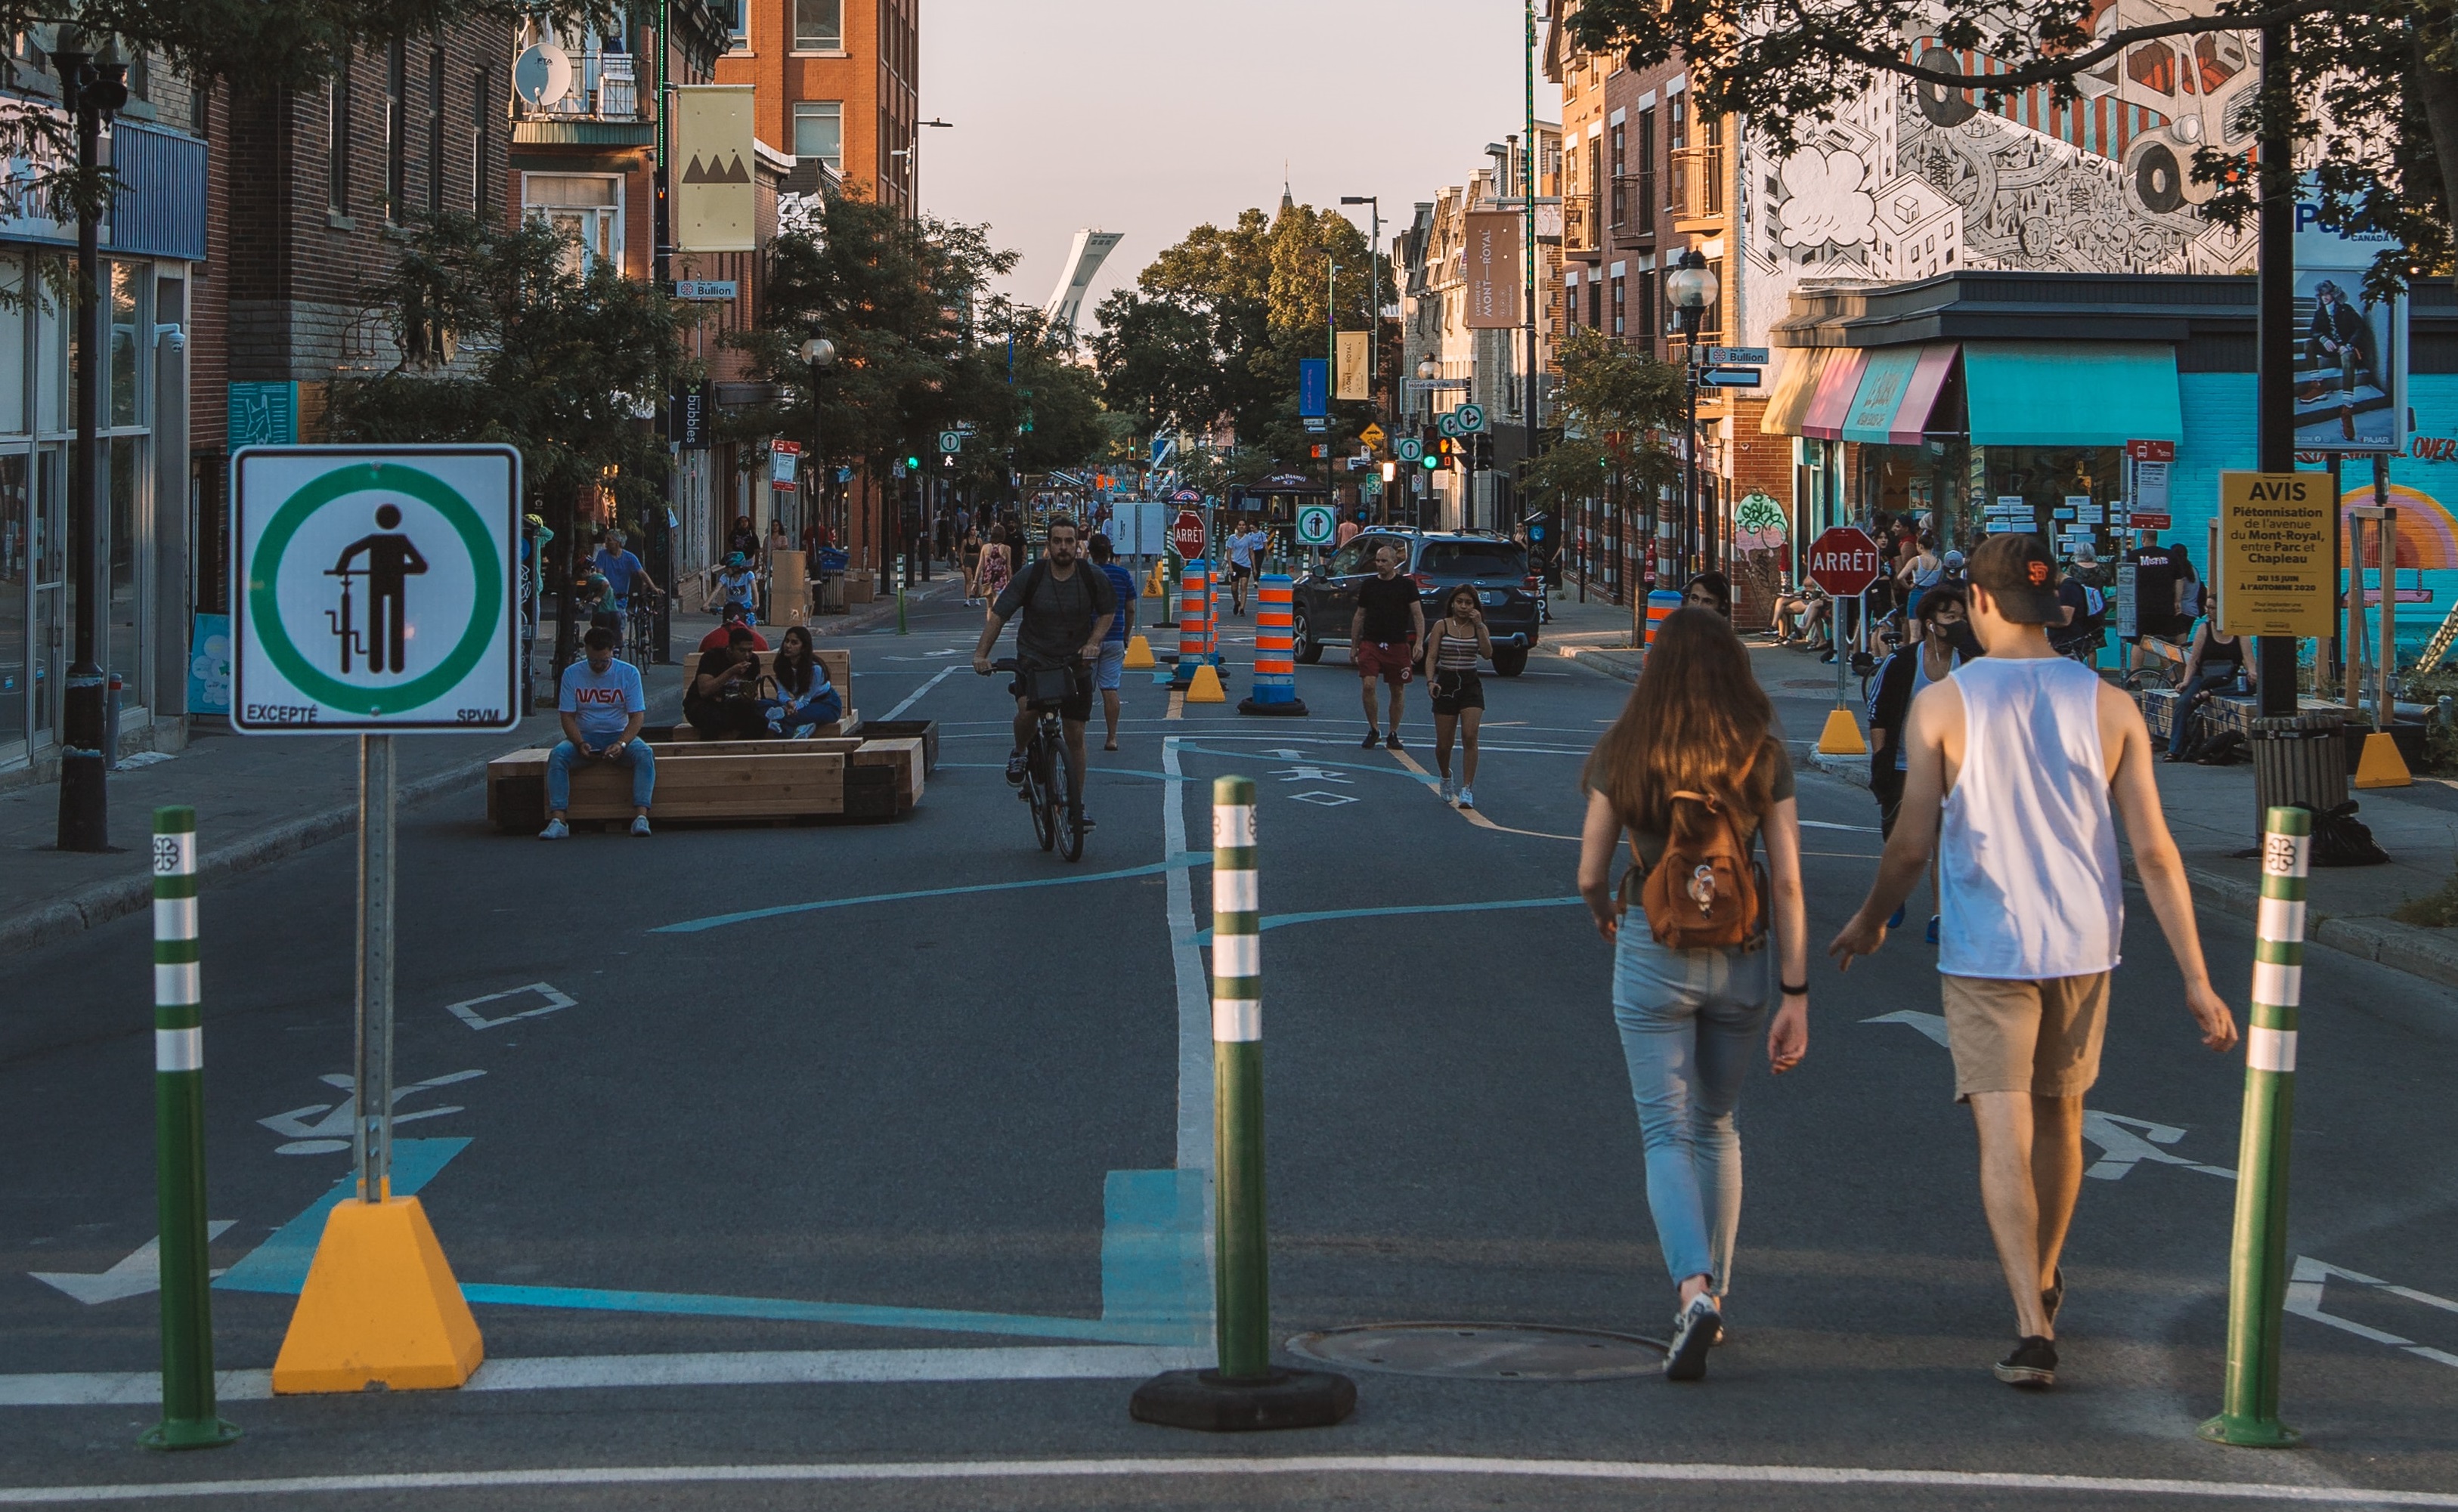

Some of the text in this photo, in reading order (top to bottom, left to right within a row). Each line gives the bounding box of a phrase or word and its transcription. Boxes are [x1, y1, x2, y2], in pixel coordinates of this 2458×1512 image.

[698, 286, 731, 295] Bullion
[1730, 352, 1764, 362] Bullion
[686, 395, 701, 444] bubbles
[2249, 481, 2307, 501] AVIS
[2233, 506, 2323, 518] Piétonnisation
[2244, 518, 2311, 529] de l'avenue
[1175, 527, 1203, 543] ARRÊT
[2230, 530, 2325, 543] du Mont-Royal,
[2240, 542, 2315, 552] entre Parc et
[1813, 549, 1874, 571] ARRÊT
[2248, 552, 2308, 565] Chapleau
[2280, 575, 2299, 583] JUIN
[575, 688, 624, 703] NASA
[247, 703, 500, 722] EXCEPTÉ SPVM
